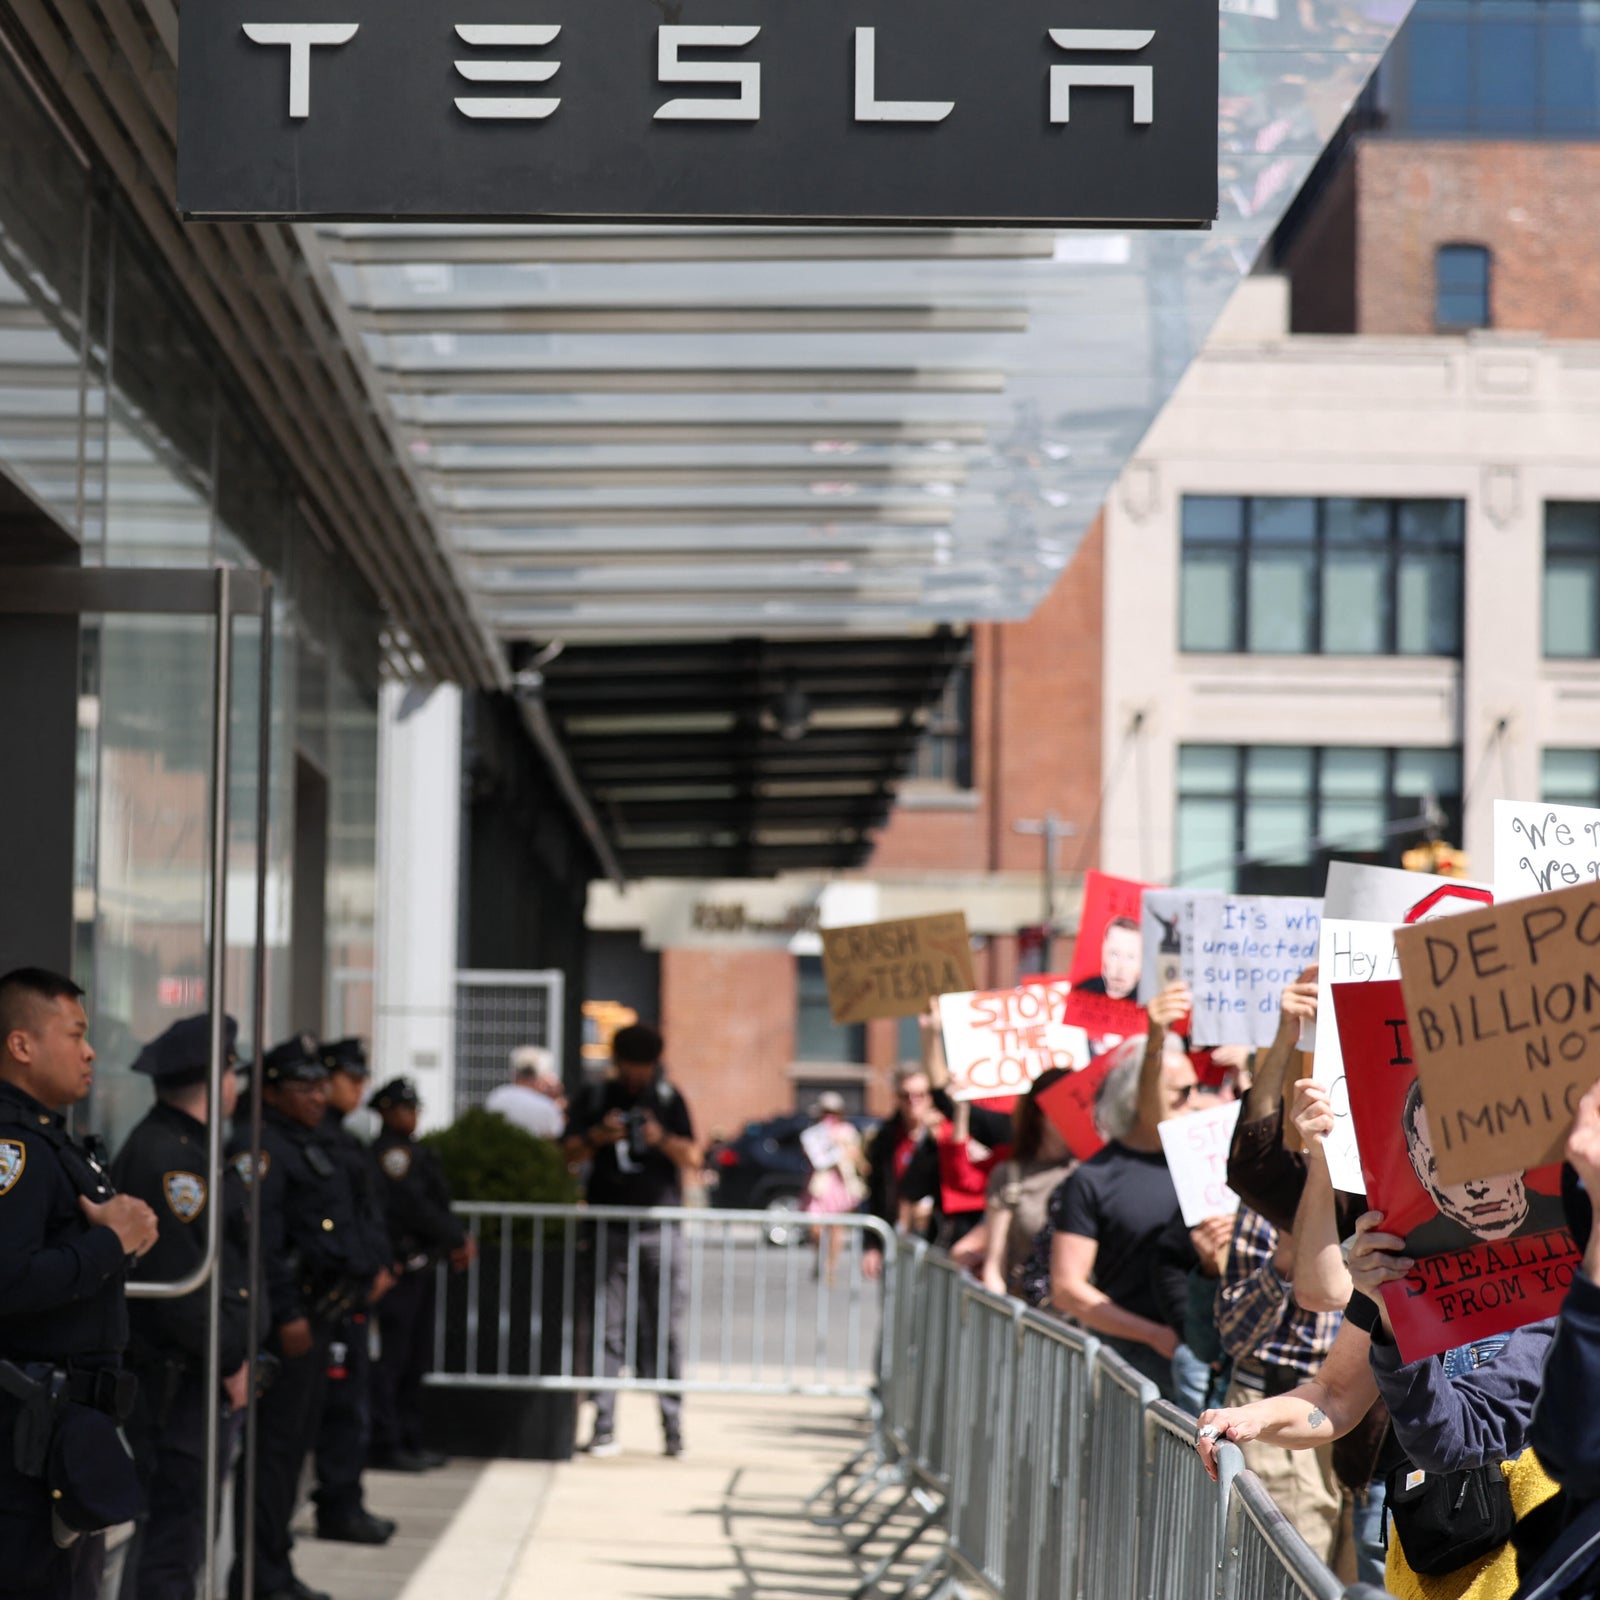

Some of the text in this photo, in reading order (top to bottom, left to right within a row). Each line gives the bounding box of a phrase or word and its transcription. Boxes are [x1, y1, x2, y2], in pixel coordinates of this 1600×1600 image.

[241, 22, 1157, 125] TESLA
[1512, 812, 1575, 850] We
[1519, 856, 1580, 893] We
[1223, 904, 1319, 930] It's wh
[1202, 935, 1317, 958] unelected
[1333, 931, 1378, 982] Hey
[969, 987, 1067, 1028] STOP
[1203, 991, 1247, 1013] the
[991, 1024, 1049, 1051] THE
[966, 1050, 1075, 1089] COUP
[1435, 1275, 1527, 1324] FROM
